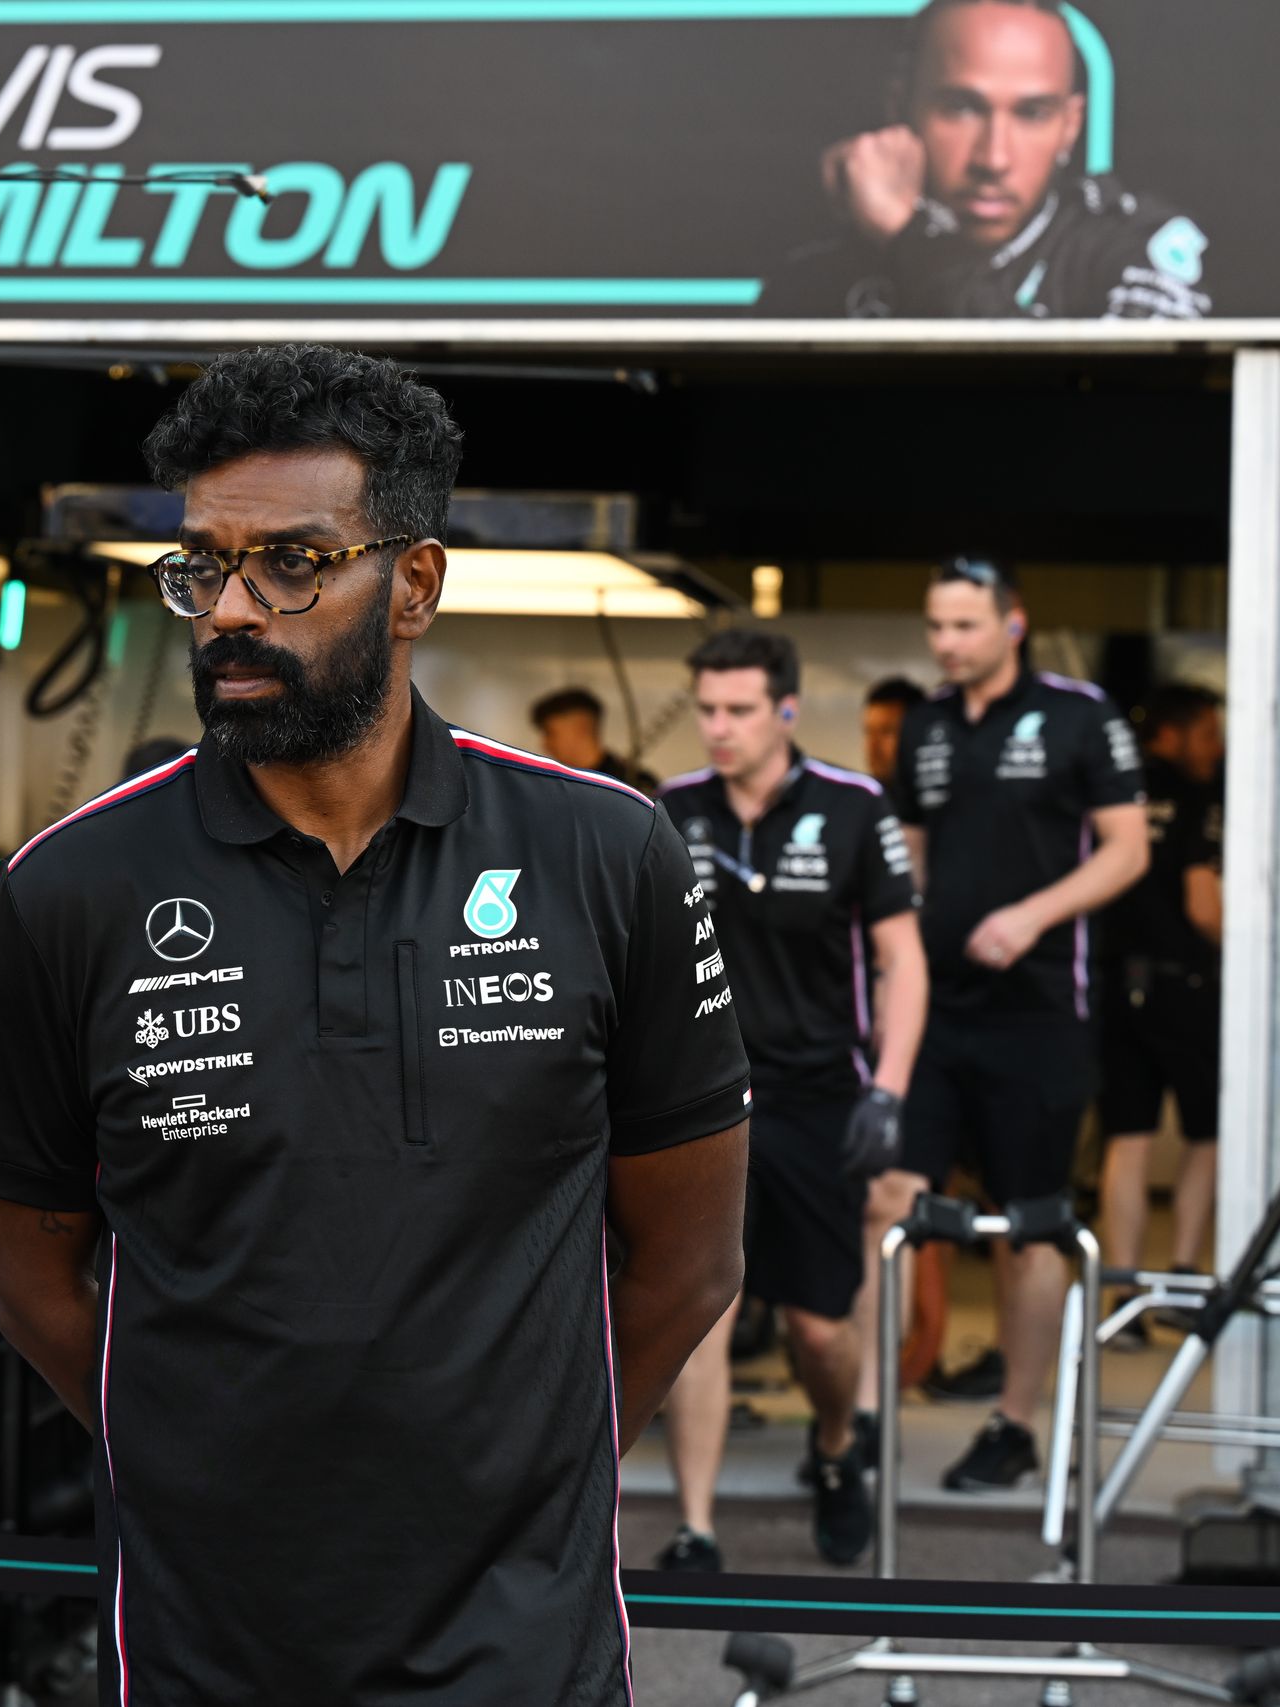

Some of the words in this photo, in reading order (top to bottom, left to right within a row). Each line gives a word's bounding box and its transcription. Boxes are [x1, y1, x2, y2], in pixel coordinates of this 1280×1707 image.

[449, 937, 540, 958] PETRONAS
[166, 966, 244, 987] AMG
[442, 971, 554, 1008] INEOS
[173, 1003, 241, 1038] UBS
[458, 1025, 565, 1044] TeamViewer
[135, 1052, 254, 1079] CROWDSTRIKE
[141, 1110, 188, 1130] Hewlett
[190, 1103, 251, 1124] Packard
[161, 1122, 228, 1142] Enterprise
